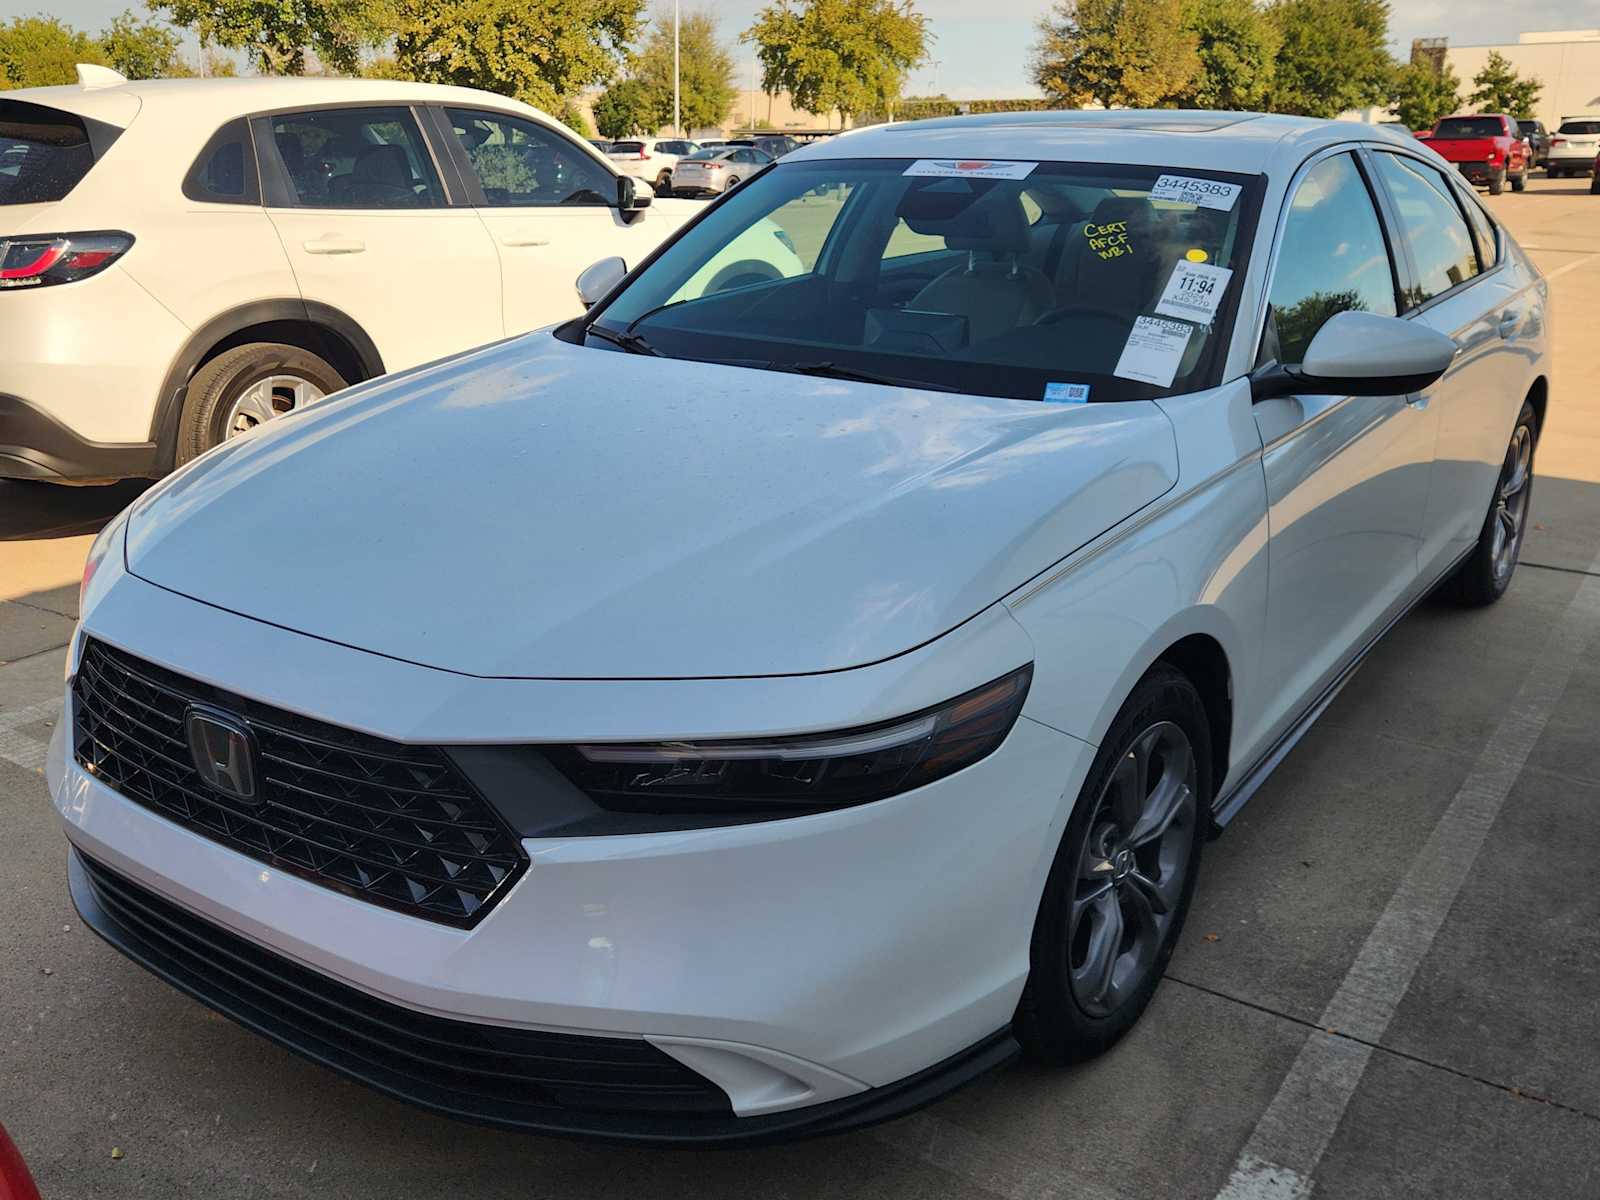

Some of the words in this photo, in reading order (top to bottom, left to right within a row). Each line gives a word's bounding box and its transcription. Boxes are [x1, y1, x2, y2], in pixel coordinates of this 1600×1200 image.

[1157, 177, 1232, 197] 3445383
[1083, 221, 1128, 237] CERT
[1089, 232, 1128, 250] AFCF
[1180, 277, 1215, 295] 11:94
